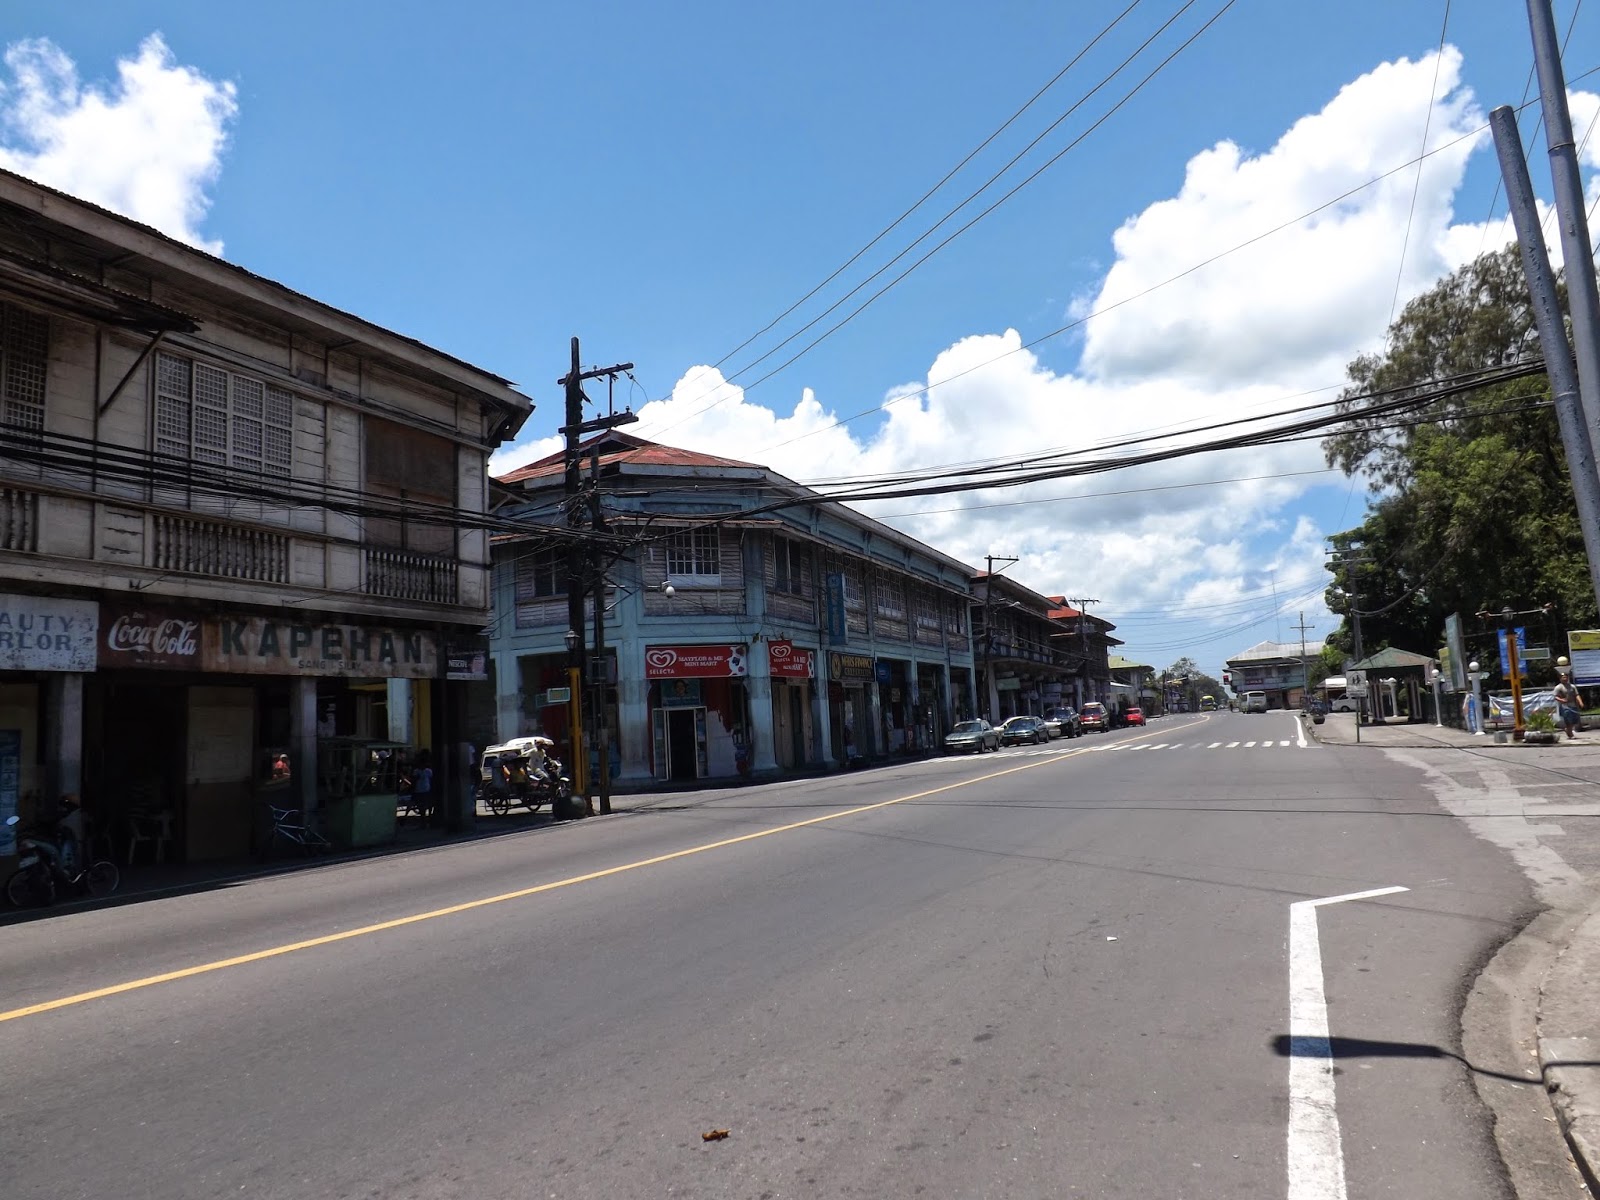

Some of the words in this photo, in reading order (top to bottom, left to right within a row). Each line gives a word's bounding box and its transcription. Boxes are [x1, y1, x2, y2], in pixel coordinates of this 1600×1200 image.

[108, 615, 198, 656] Coca-Cola
[221, 621, 421, 664] KAPEHAN
[298, 659, 326, 670] SANG
[649, 668, 675, 676] SELECTA
